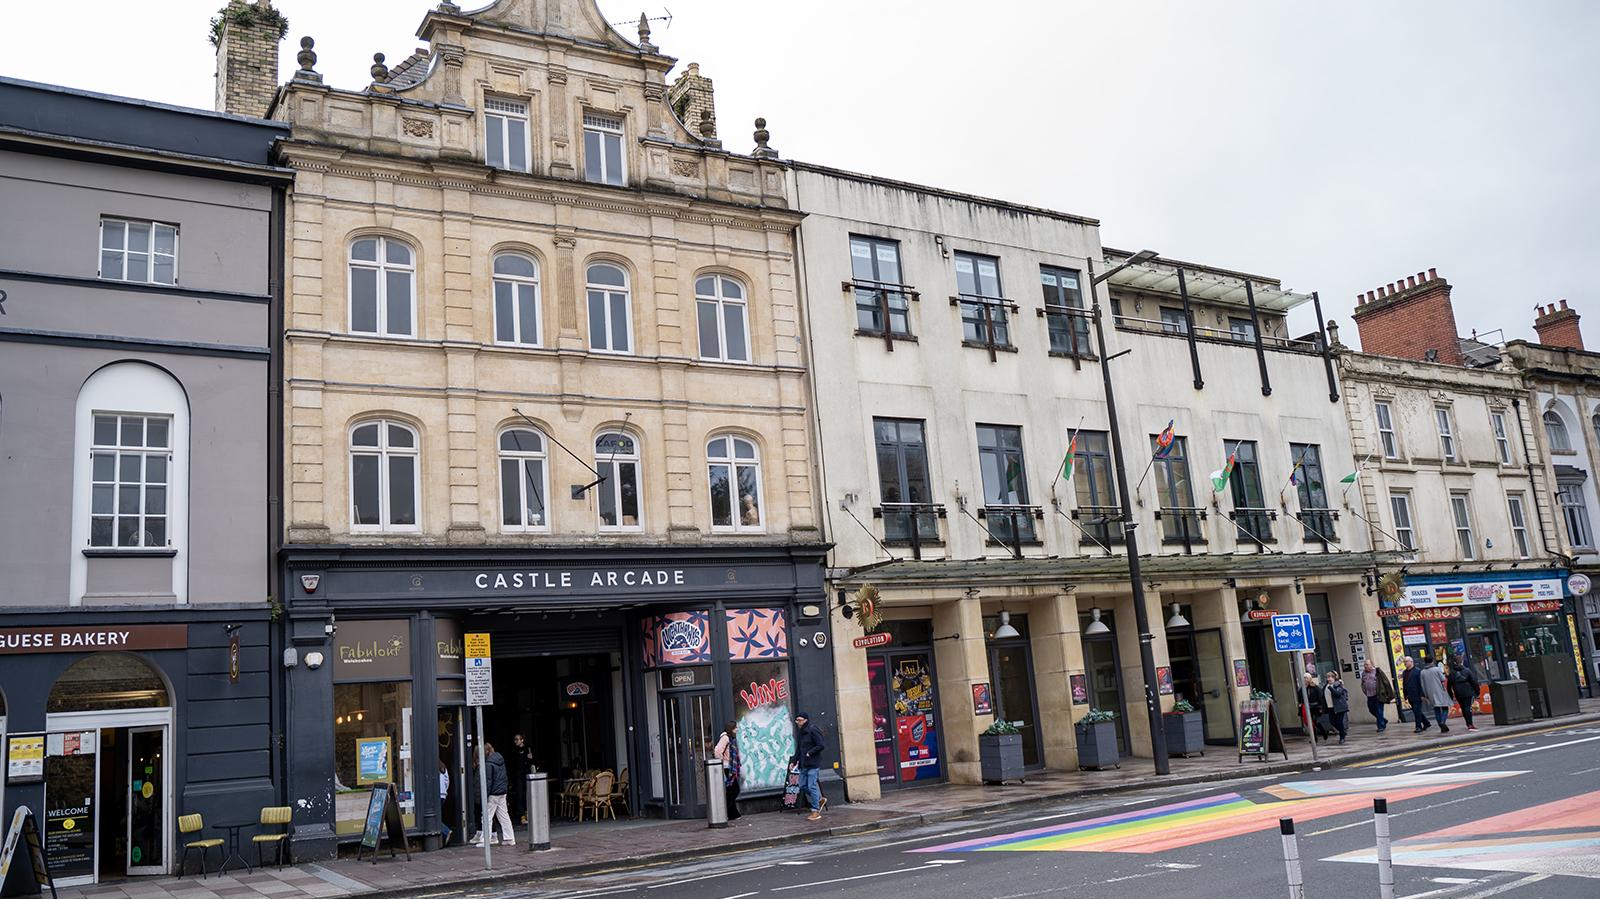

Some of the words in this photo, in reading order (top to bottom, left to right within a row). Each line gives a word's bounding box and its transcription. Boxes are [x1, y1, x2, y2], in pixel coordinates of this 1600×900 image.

[475, 573, 572, 588] CASTLE
[590, 570, 684, 586] ARCADE
[60, 631, 130, 646] BAKERY
[741, 679, 787, 710] WINE
[48, 807, 89, 816] WELCOME
